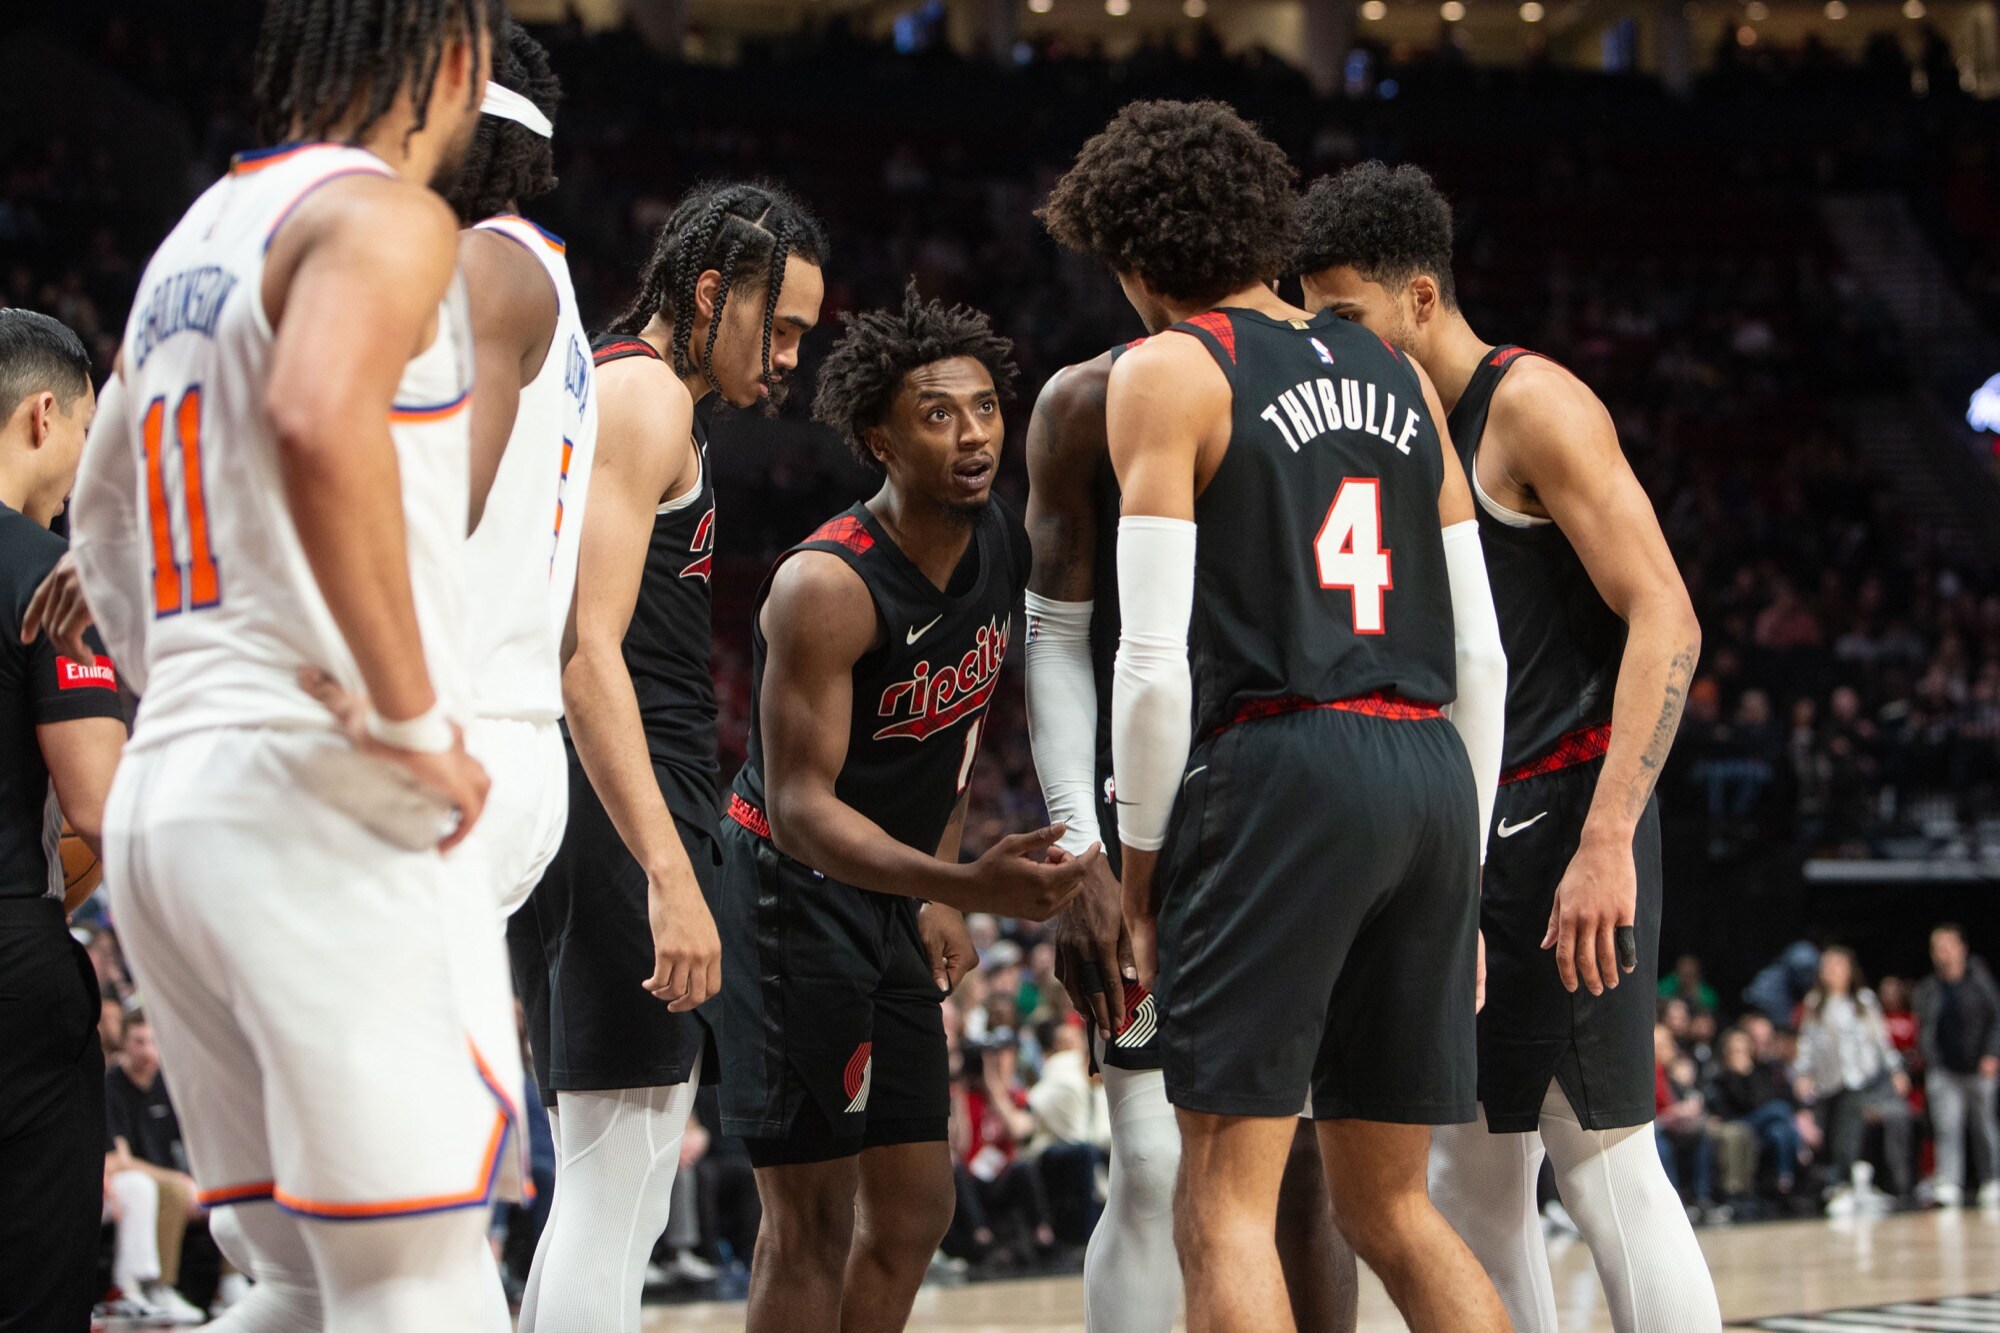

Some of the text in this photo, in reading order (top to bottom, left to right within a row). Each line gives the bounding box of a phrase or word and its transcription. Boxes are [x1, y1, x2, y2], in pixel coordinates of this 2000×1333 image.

[1260, 378, 1420, 456] THYBULLE
[140, 383, 221, 619] 11
[1313, 477, 1394, 635] 4
[957, 717, 984, 794] 1
